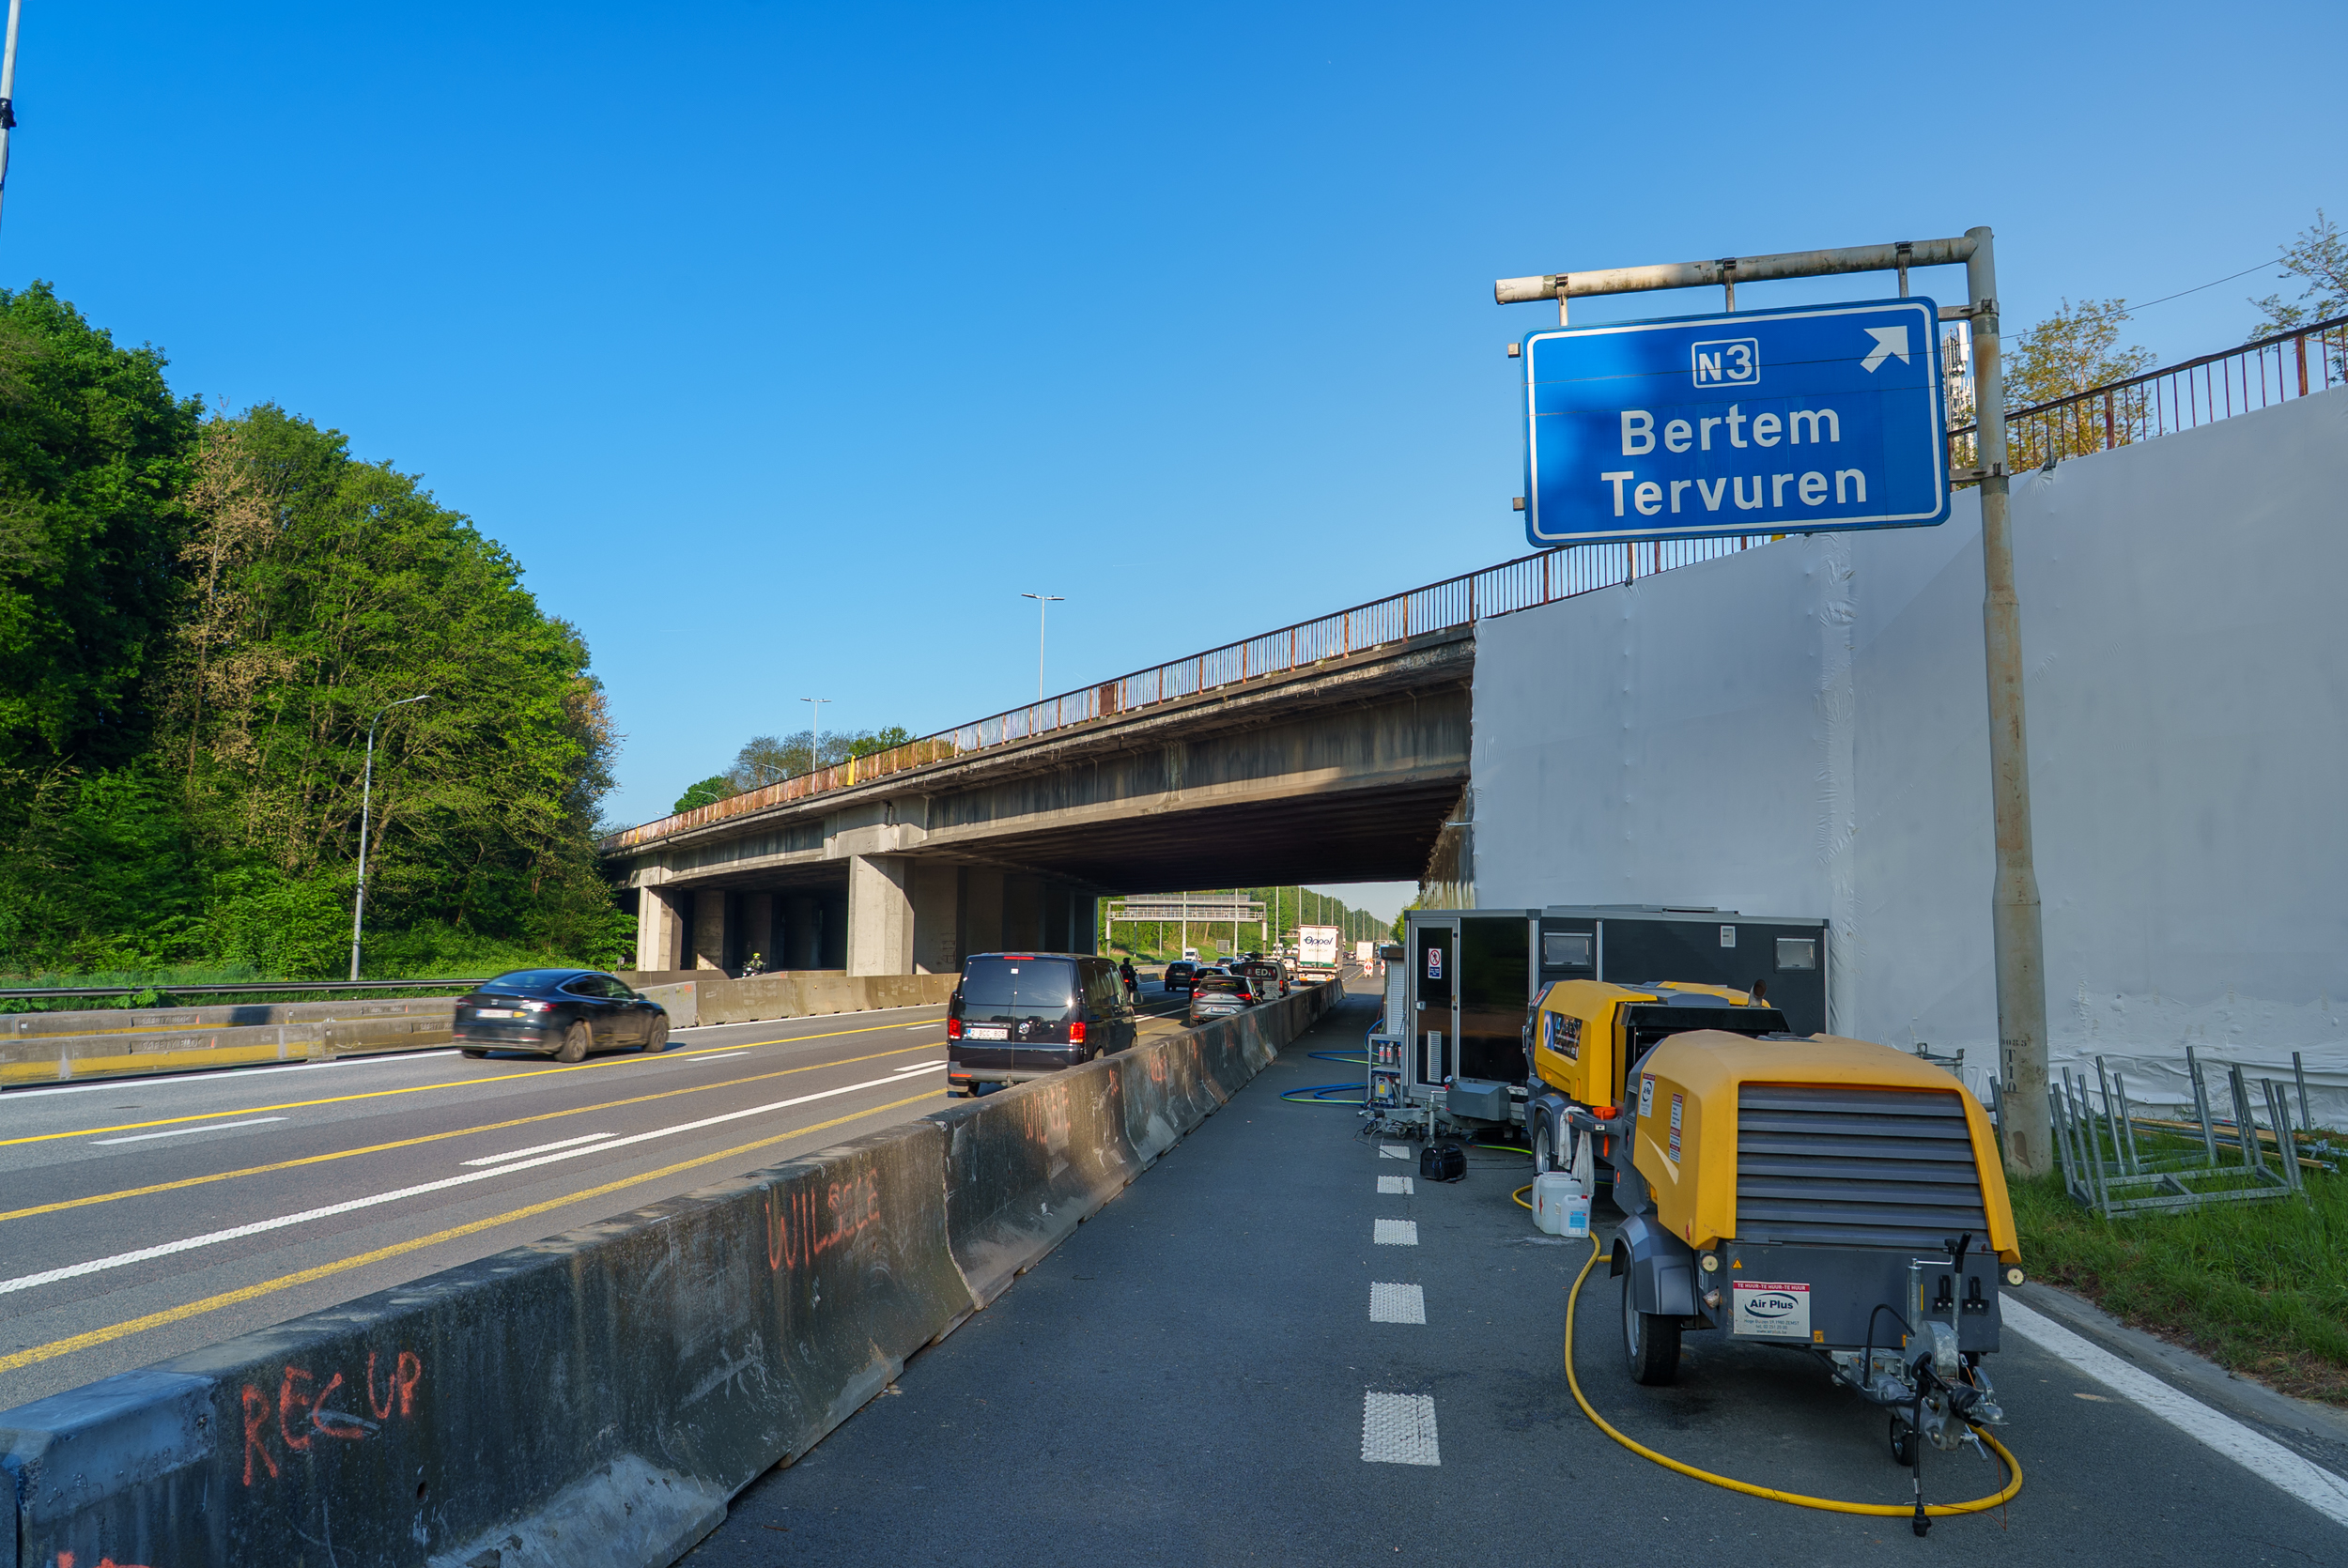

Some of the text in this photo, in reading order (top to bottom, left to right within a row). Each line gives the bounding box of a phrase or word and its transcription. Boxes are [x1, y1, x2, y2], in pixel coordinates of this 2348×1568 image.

[1698, 345, 1753, 382] N3
[1620, 404, 1841, 456] Bertem
[1601, 468, 1866, 517] Tervuren
[1304, 935, 1334, 946] Oppel
[142, 1038, 204, 1052] SAFETY BLOC
[1750, 1299, 1794, 1310] Air Plus
